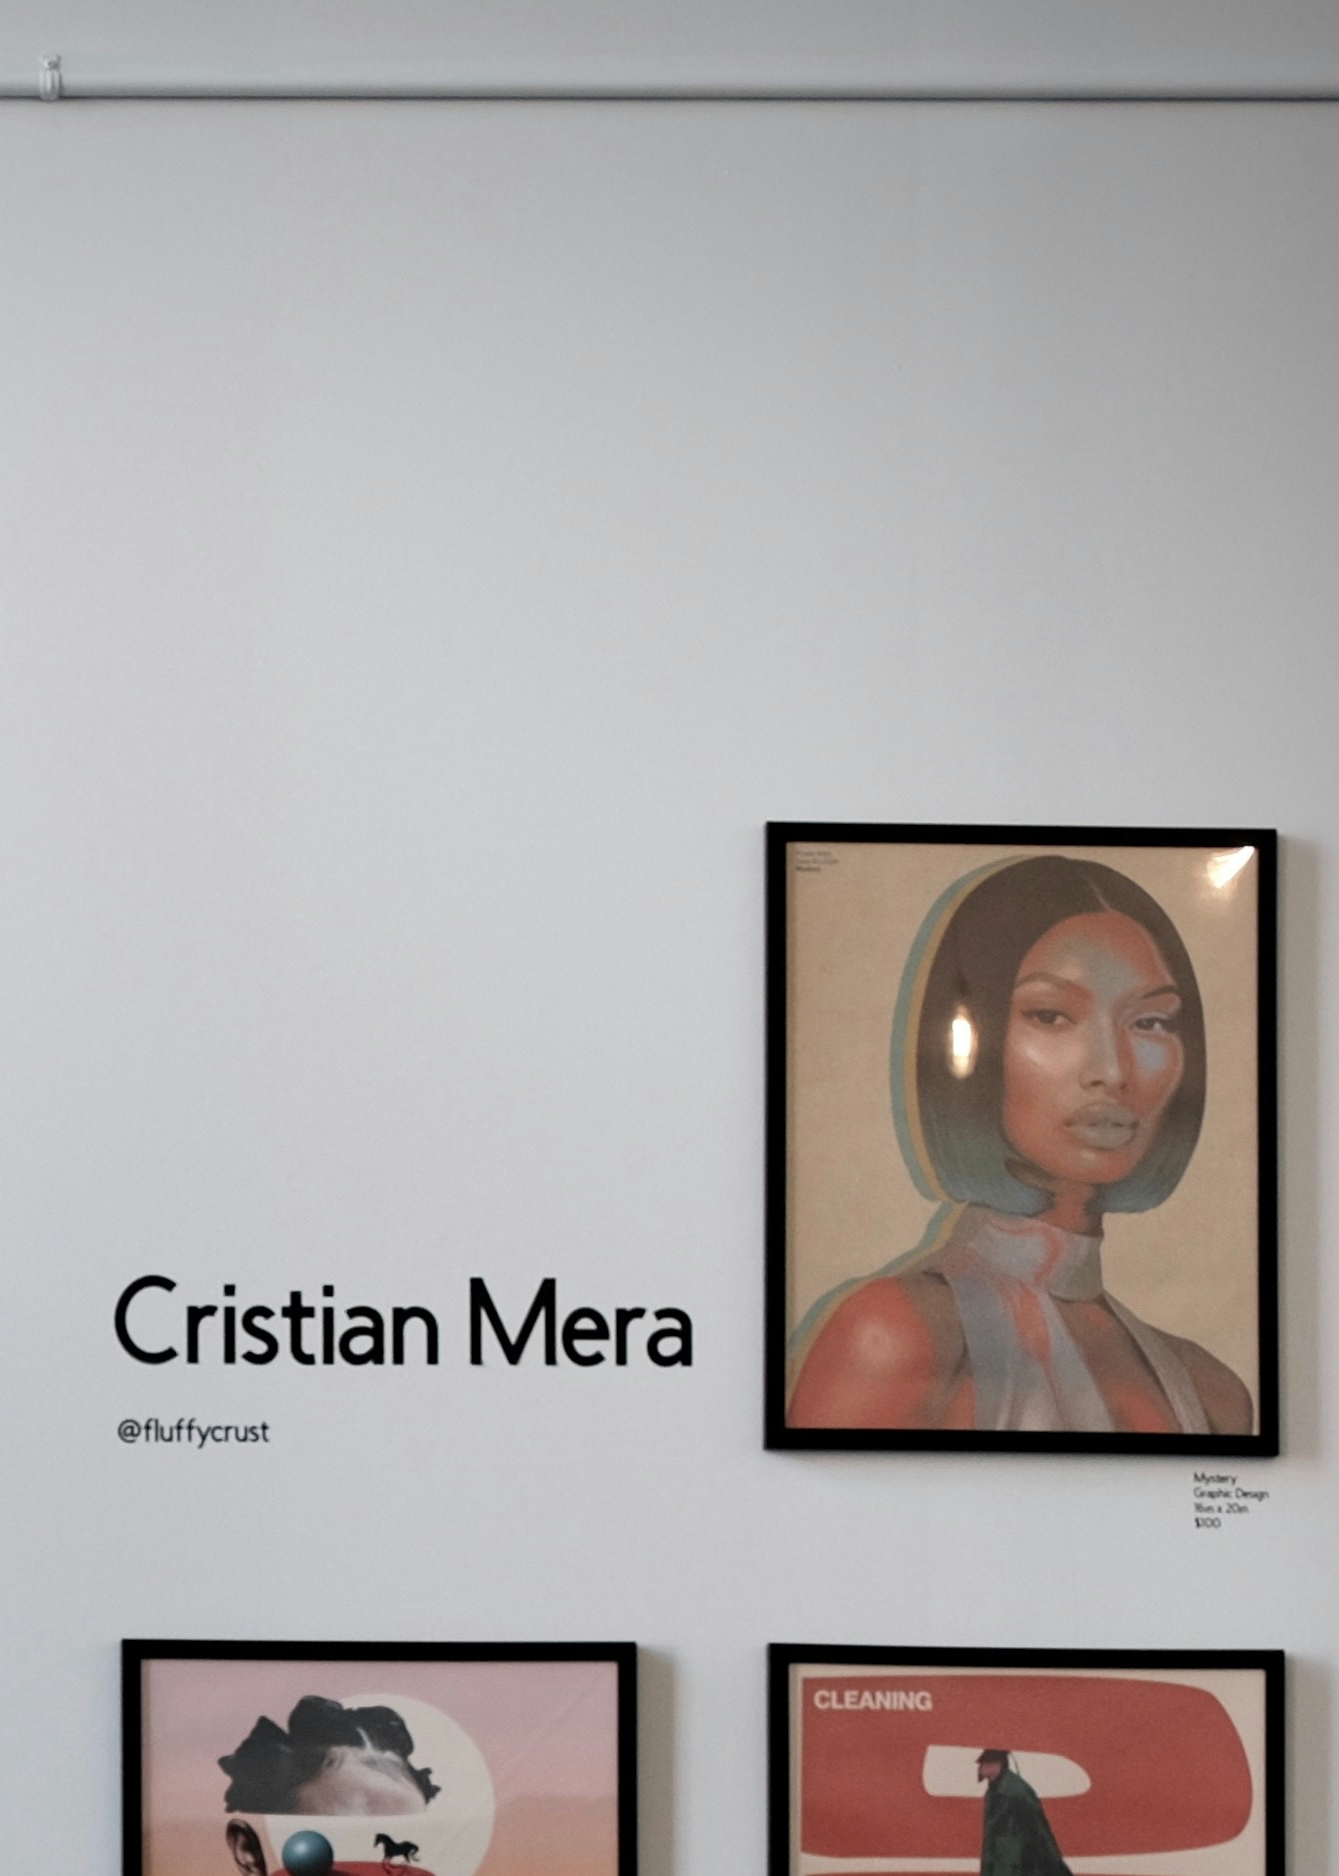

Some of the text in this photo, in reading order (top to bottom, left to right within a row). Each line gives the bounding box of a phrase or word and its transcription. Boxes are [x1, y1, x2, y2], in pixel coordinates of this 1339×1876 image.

[114, 1275, 694, 1367] Cristian Mera
[118, 1417, 270, 1449] @fluffycrust
[1193, 1472, 1237, 1486] Mystery
[1235, 1487, 1270, 1502] Design
[813, 1689, 933, 1711] CLEANING
